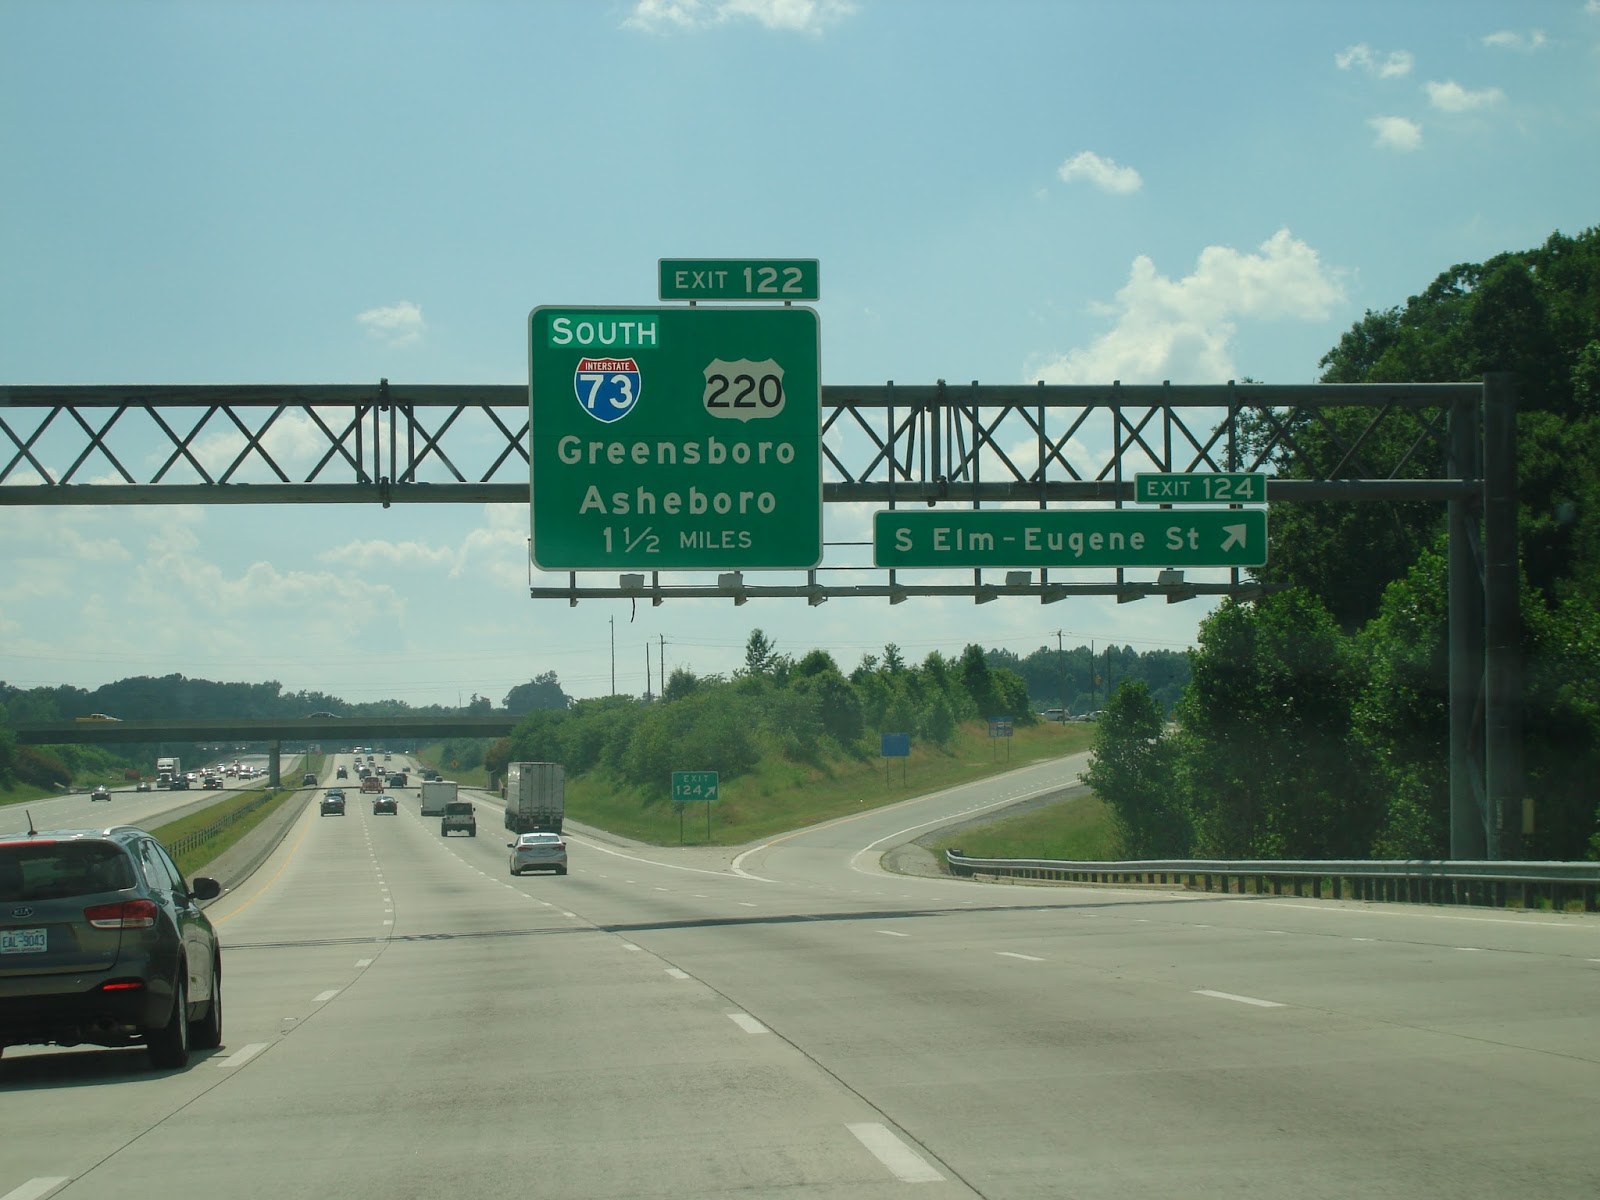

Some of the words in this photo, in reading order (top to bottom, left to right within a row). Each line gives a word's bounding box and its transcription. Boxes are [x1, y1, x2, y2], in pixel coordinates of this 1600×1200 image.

[675, 271, 728, 289] EXIT
[743, 267, 803, 293] 122
[552, 317, 656, 345] SOUTH
[585, 362, 630, 371] INTERSTATE
[580, 374, 633, 409] 73
[706, 374, 783, 408] 220
[557, 435, 795, 465] Greensboro
[578, 485, 776, 514] Asheboro
[1147, 481, 1190, 496] EXIT
[1203, 477, 1254, 500] 124
[680, 530, 752, 549] MILES
[895, 527, 913, 552] S
[1165, 526, 1199, 551] St
[676, 784, 702, 796] 124
[683, 774, 709, 783] EXIT
